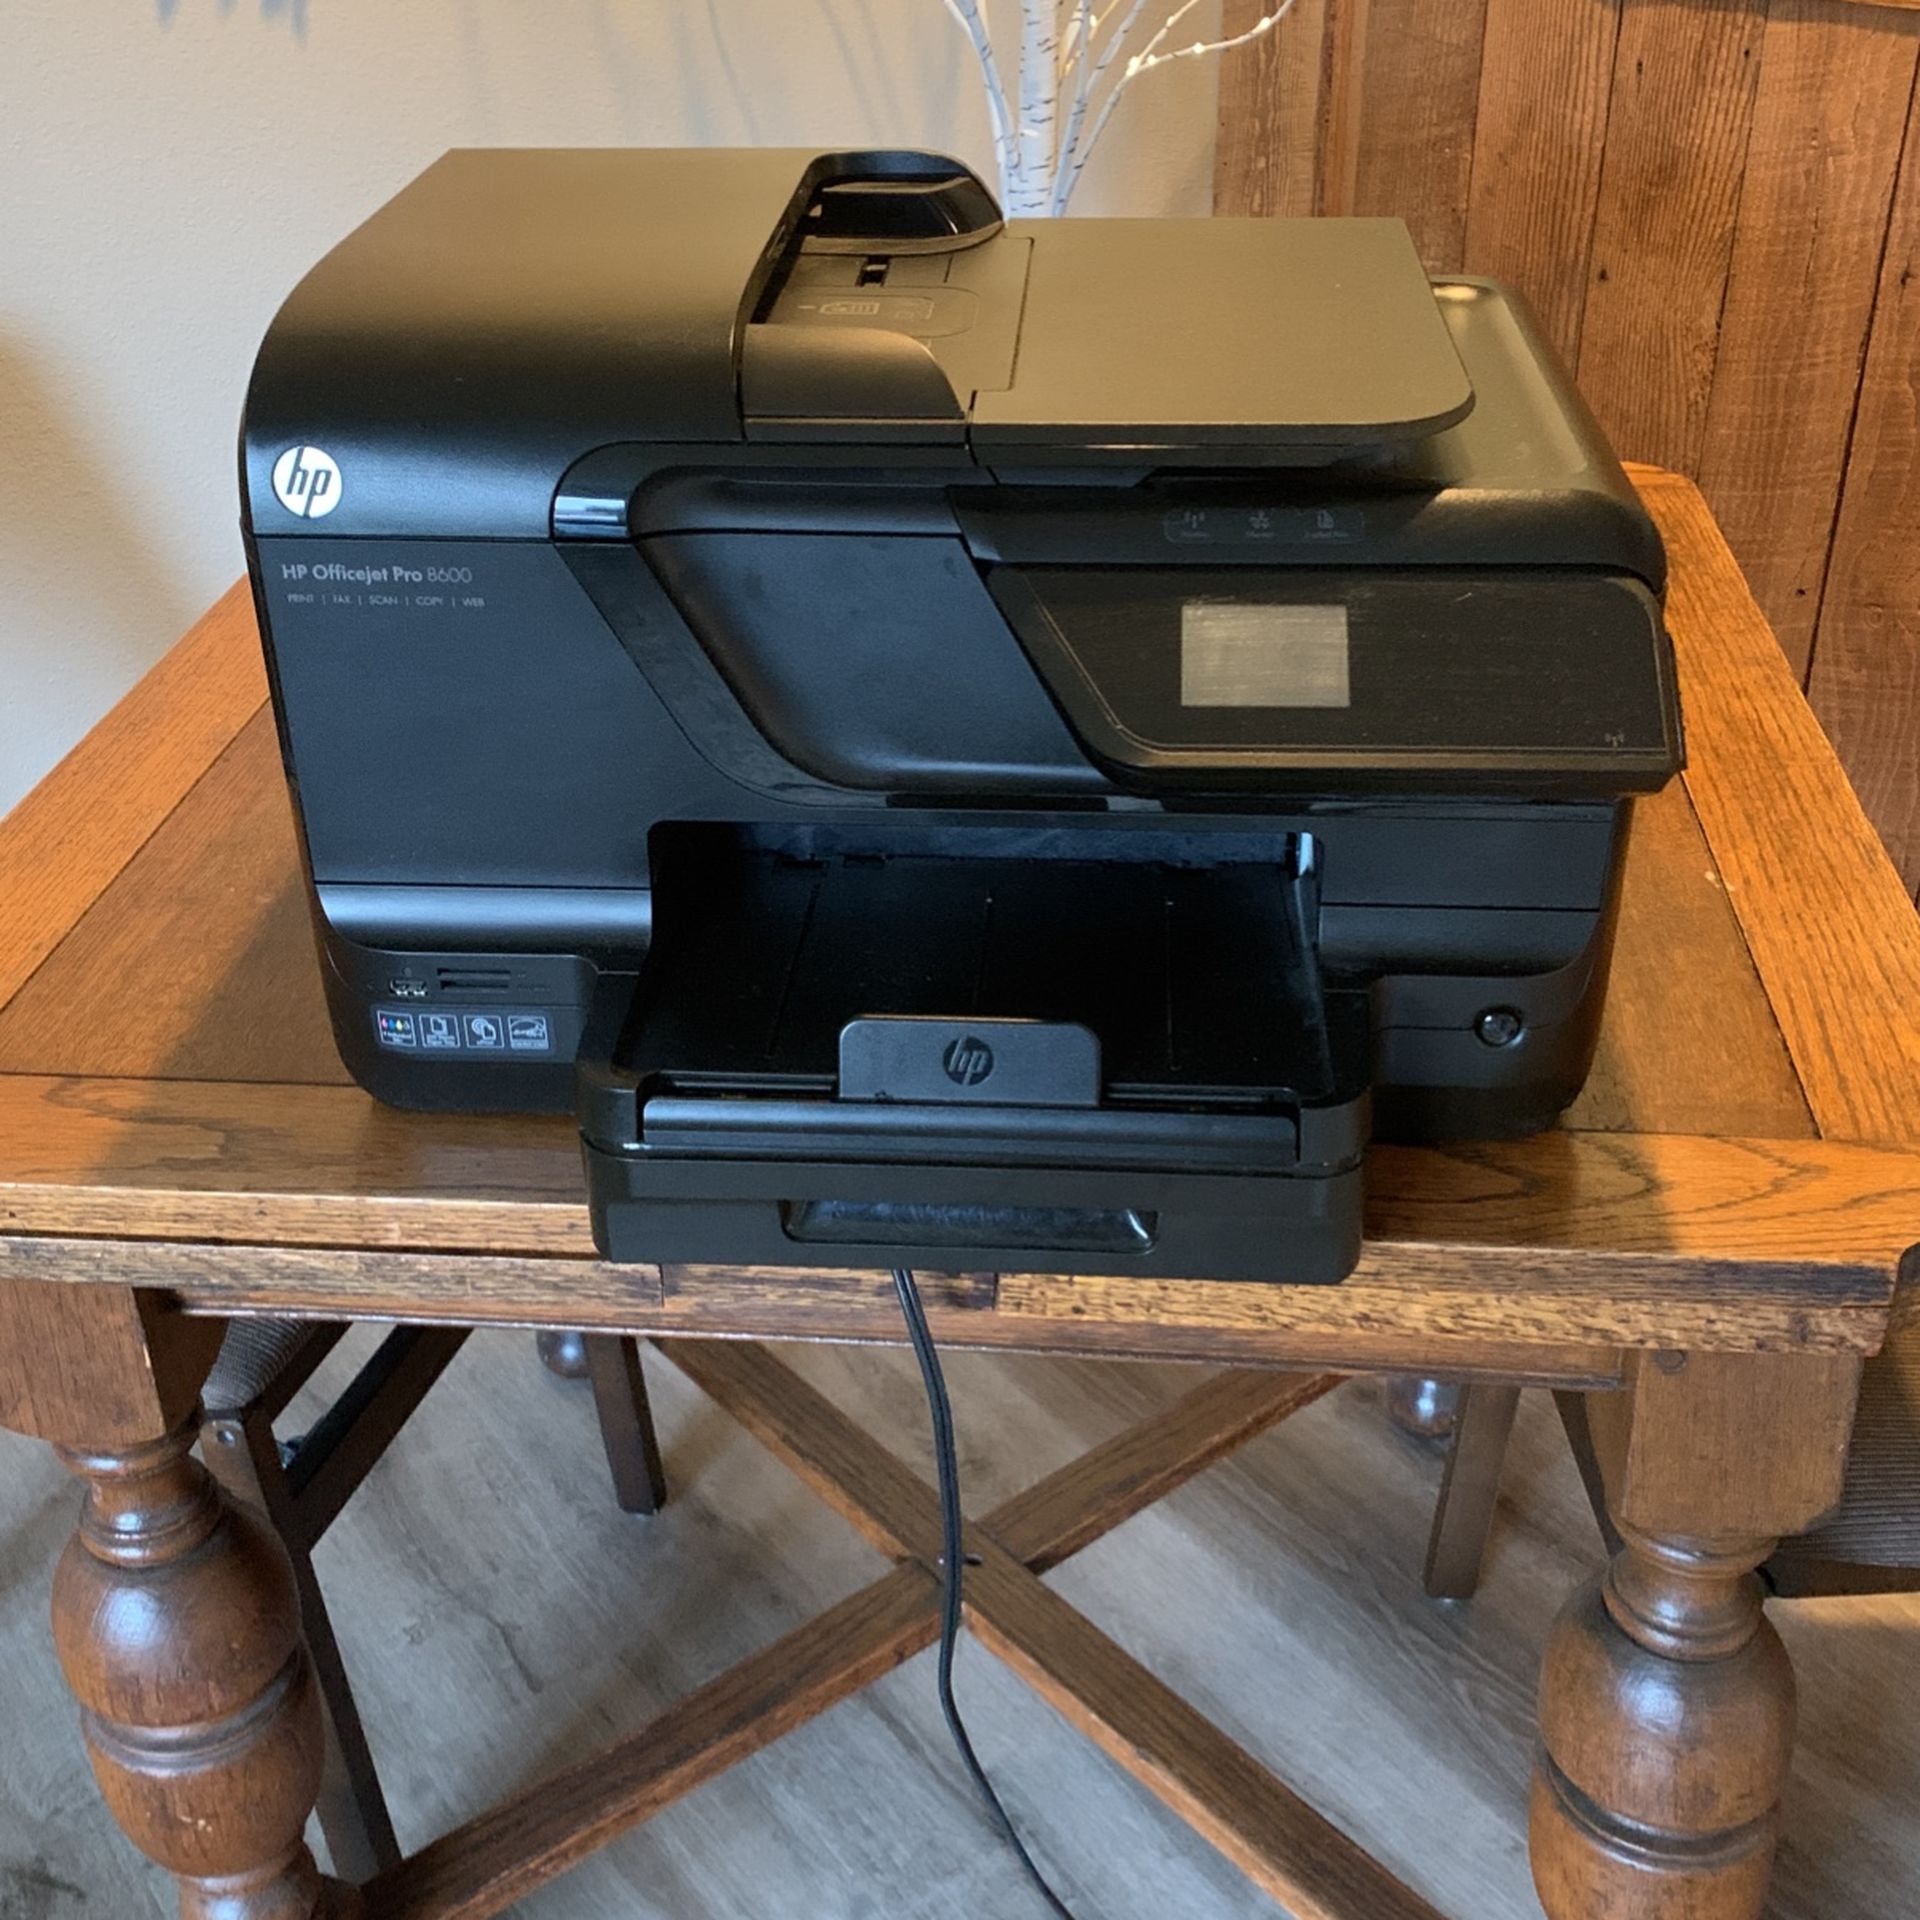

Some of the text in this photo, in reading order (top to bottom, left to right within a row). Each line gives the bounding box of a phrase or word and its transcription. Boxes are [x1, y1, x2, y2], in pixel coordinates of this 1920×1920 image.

[285, 446, 333, 518] hp
[281, 564, 472, 586] HP Officejet Pro 8600
[369, 595, 398, 606] SCAN
[415, 595, 443, 607] COPY
[462, 597, 486, 608] WEB
[948, 1035, 988, 1086] hp
